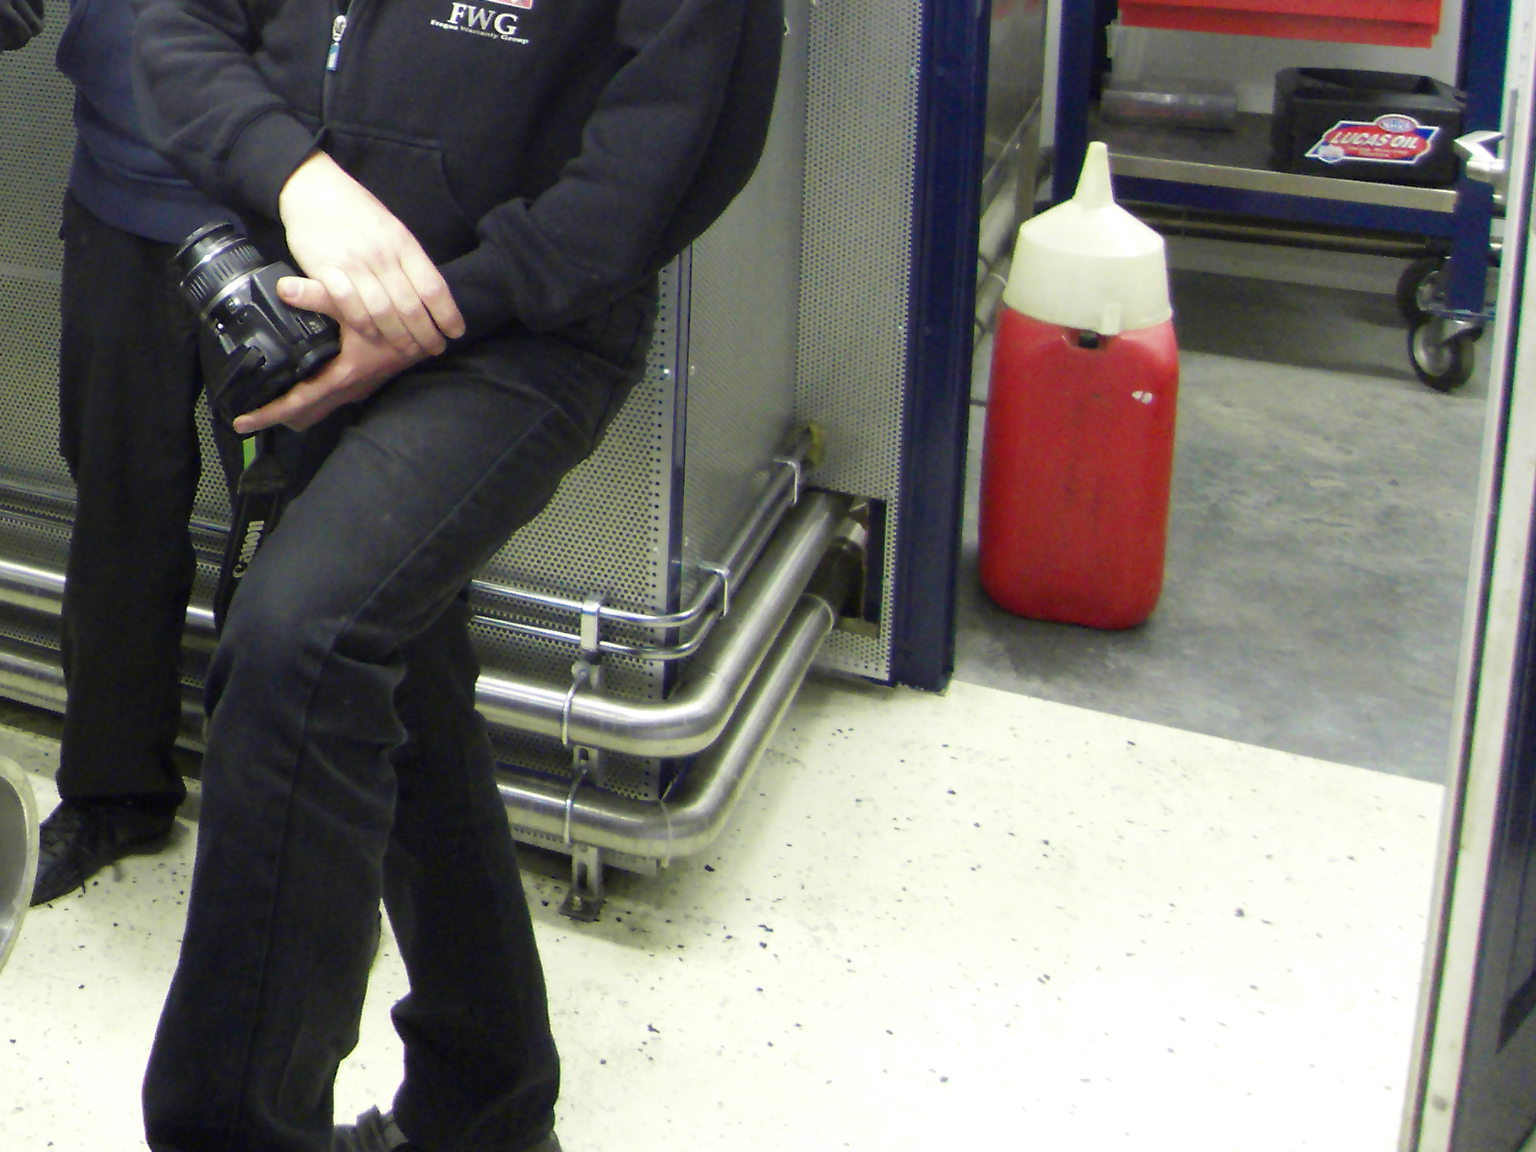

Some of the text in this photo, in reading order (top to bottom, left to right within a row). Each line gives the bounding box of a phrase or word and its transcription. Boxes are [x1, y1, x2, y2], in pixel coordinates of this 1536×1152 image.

[447, 2, 519, 36] FWG
[1329, 131, 1420, 150] LUCAS OIL
